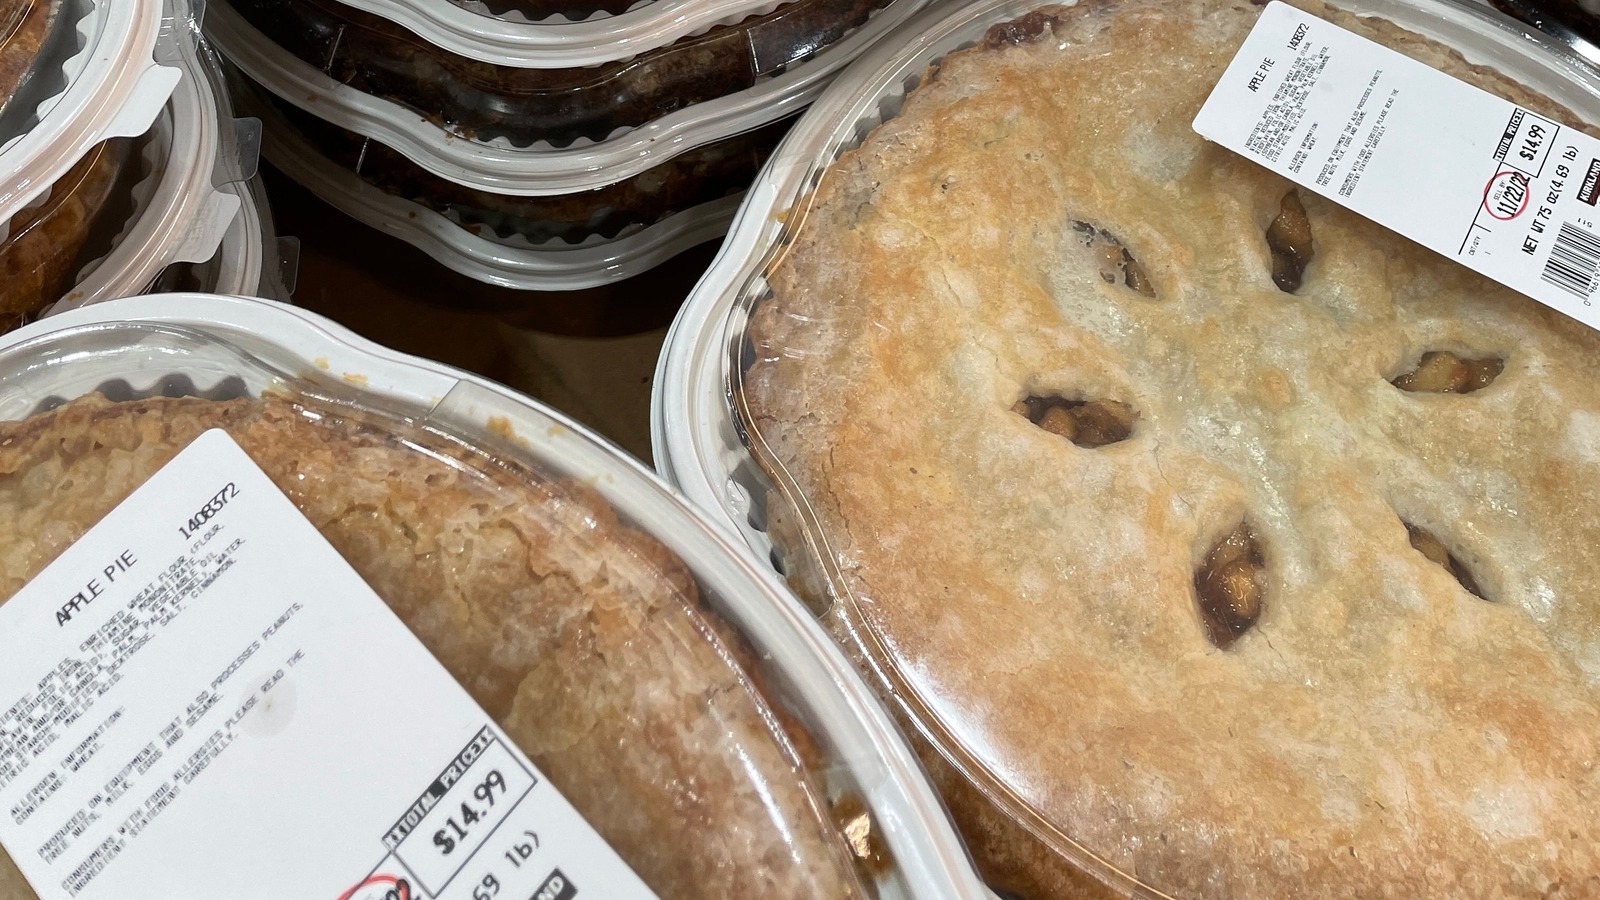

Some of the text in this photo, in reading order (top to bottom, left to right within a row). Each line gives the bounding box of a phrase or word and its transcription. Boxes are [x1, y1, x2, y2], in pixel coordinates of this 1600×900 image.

[1287, 23, 1309, 50] 1408372
[1248, 58, 1275, 92] APPLE PIE
[1520, 125, 1546, 160] $14.99
[1563, 146, 1578, 161] lb)
[1493, 188, 1502, 200] SELL
[1497, 172, 1530, 218] 11/22/22
[1531, 219, 1545, 233] WT
[1537, 206, 1552, 219] 75
[1522, 235, 1538, 255] NET
[179, 483, 239, 539] 1408372
[57, 550, 136, 626] APPLE PIE
[36, 599, 304, 858] PRODUCED ON EQUIPMENT THAT ALSO PROCESSES PEANUTS,
[60, 648, 305, 891] CONSUMERS WITH FOOD ALLERGIES PLEASE READ THE
[433, 770, 506, 854] $14.99
[505, 830, 540, 868] lb)
